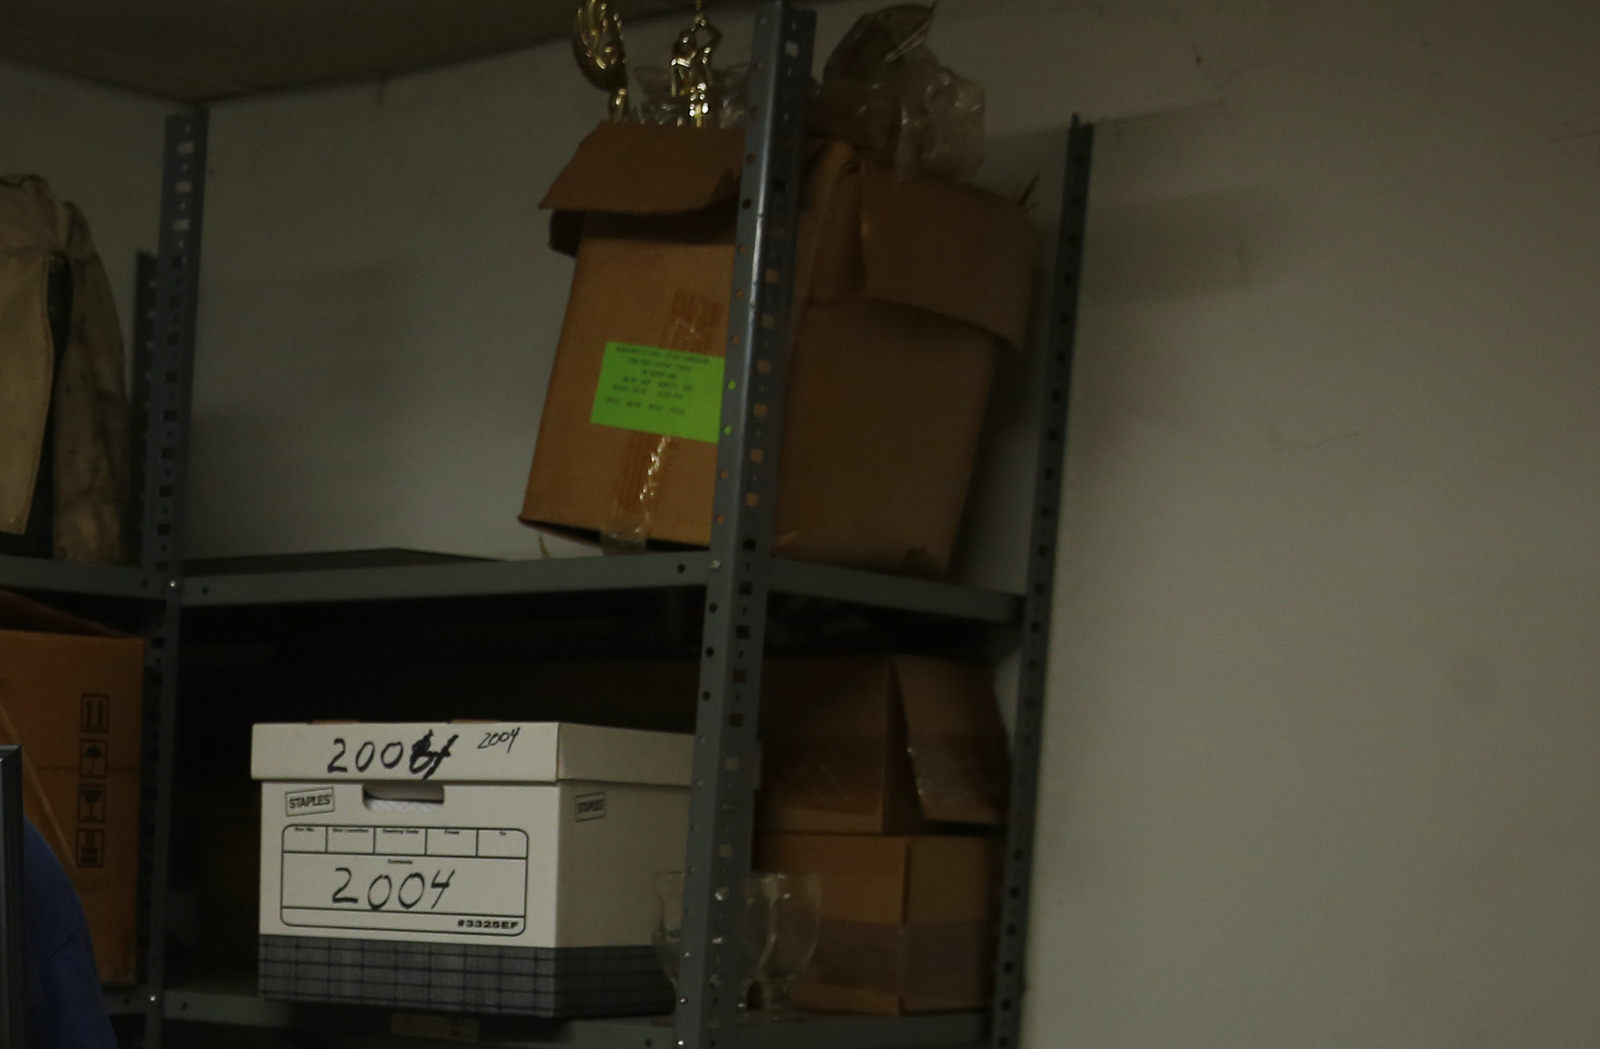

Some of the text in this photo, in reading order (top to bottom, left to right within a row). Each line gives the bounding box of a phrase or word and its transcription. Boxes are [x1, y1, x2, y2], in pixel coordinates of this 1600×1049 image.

[477, 727, 520, 753] 2004
[289, 795, 333, 810] STAPLES
[332, 867, 455, 910] 2004
[457, 919, 519, 931] #3325EF
